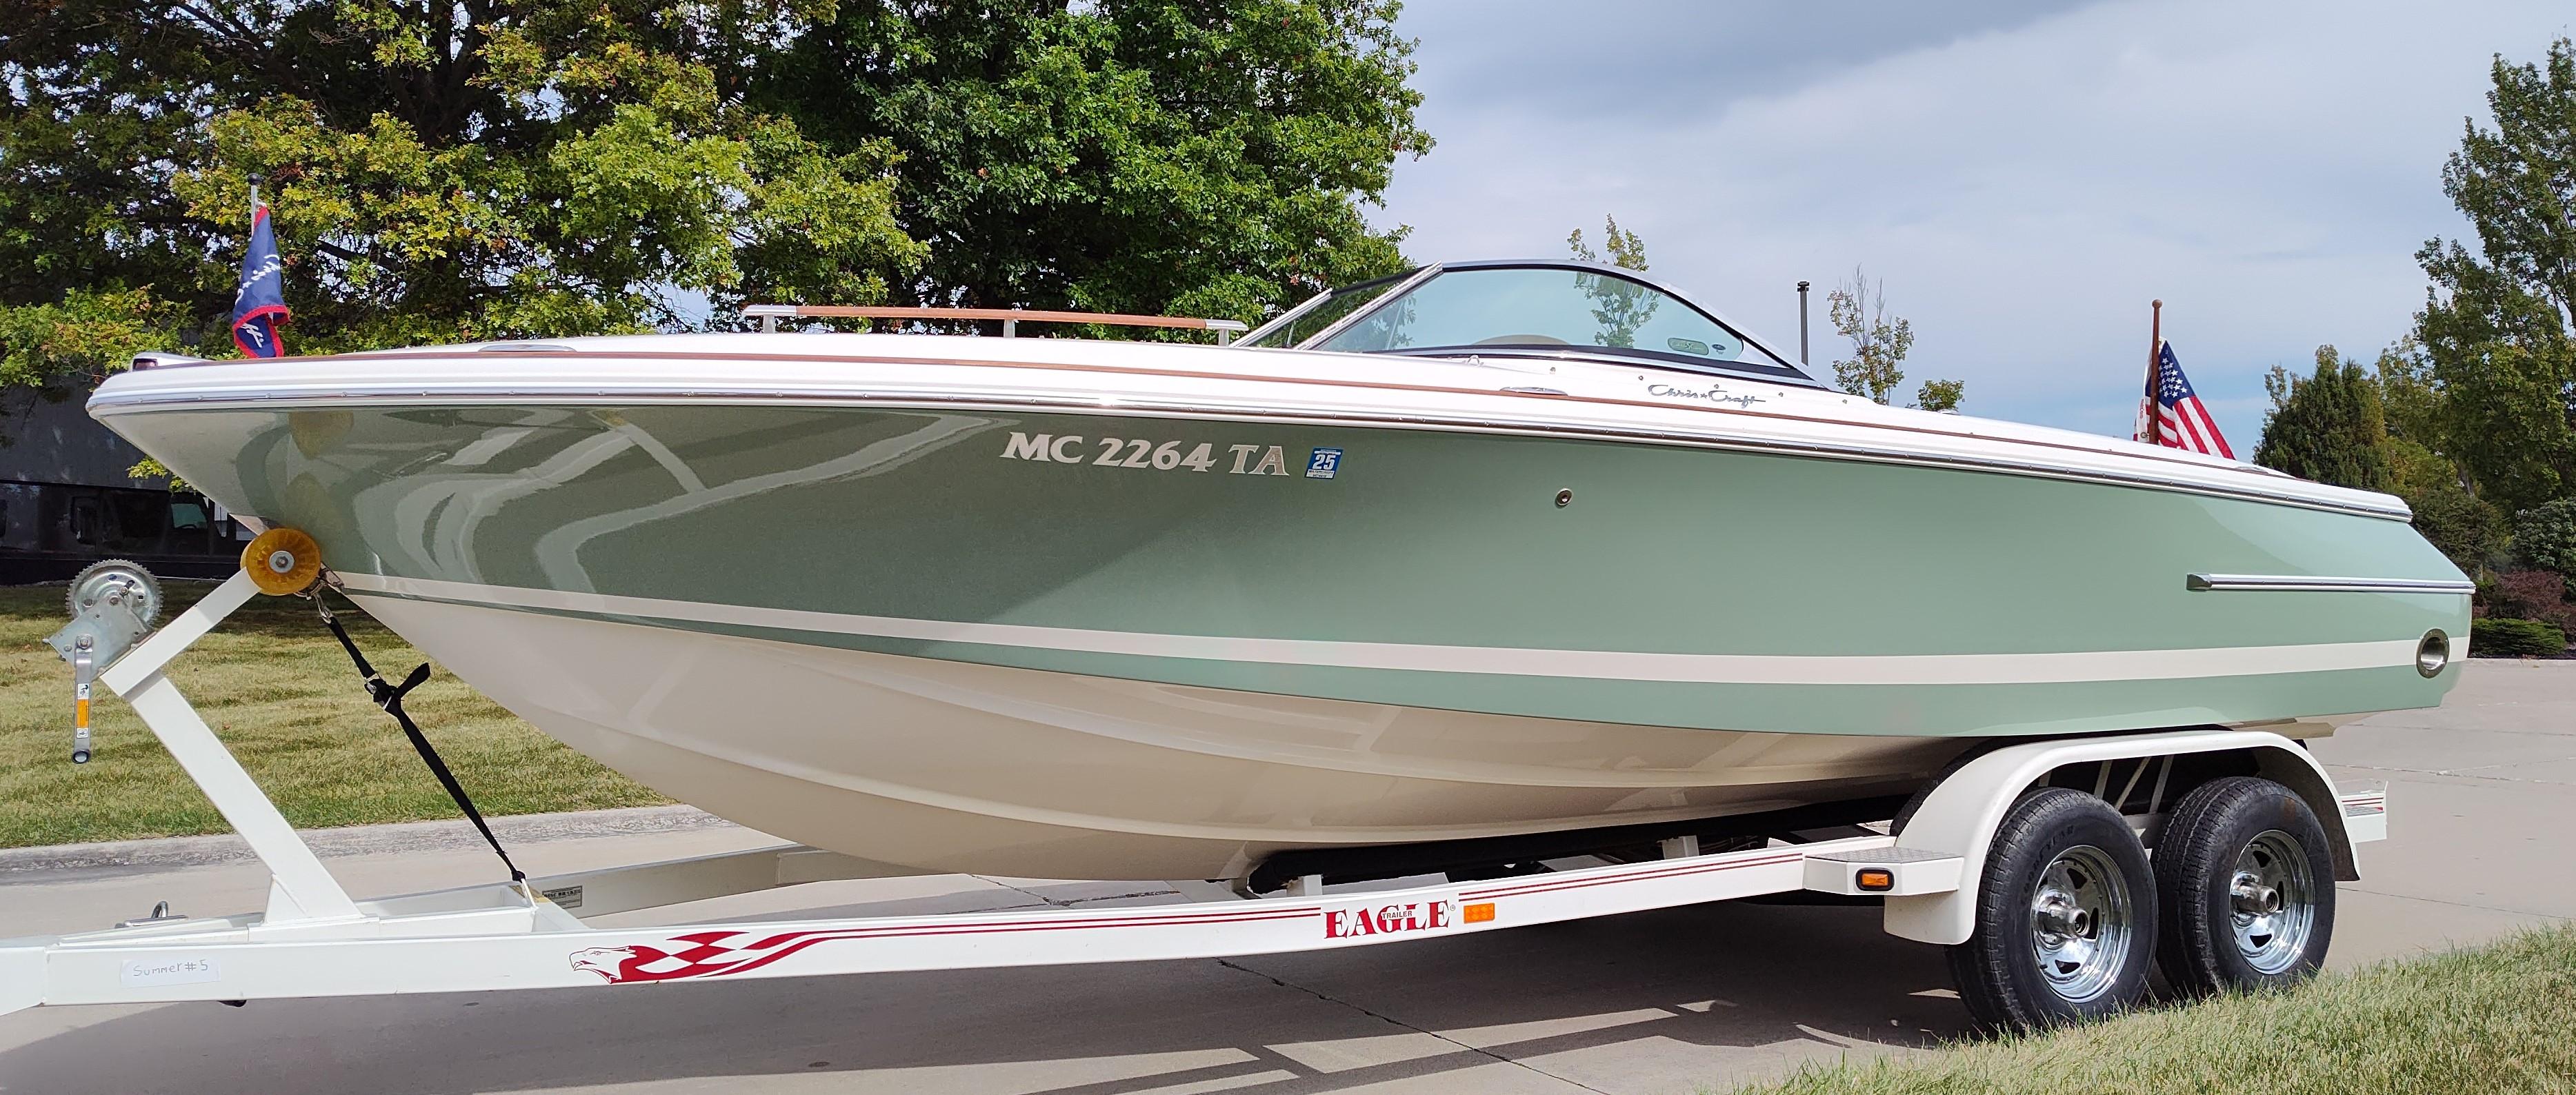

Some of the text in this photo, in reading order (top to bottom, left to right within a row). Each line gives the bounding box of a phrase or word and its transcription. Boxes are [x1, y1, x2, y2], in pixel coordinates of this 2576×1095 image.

[1648, 384, 1766, 409] Chris Craft
[999, 431, 1290, 476] MC 2264 TA
[1312, 454, 1337, 470] 25
[1323, 899, 1450, 939] EAGLE
[1382, 910, 1412, 919] TRAILER
